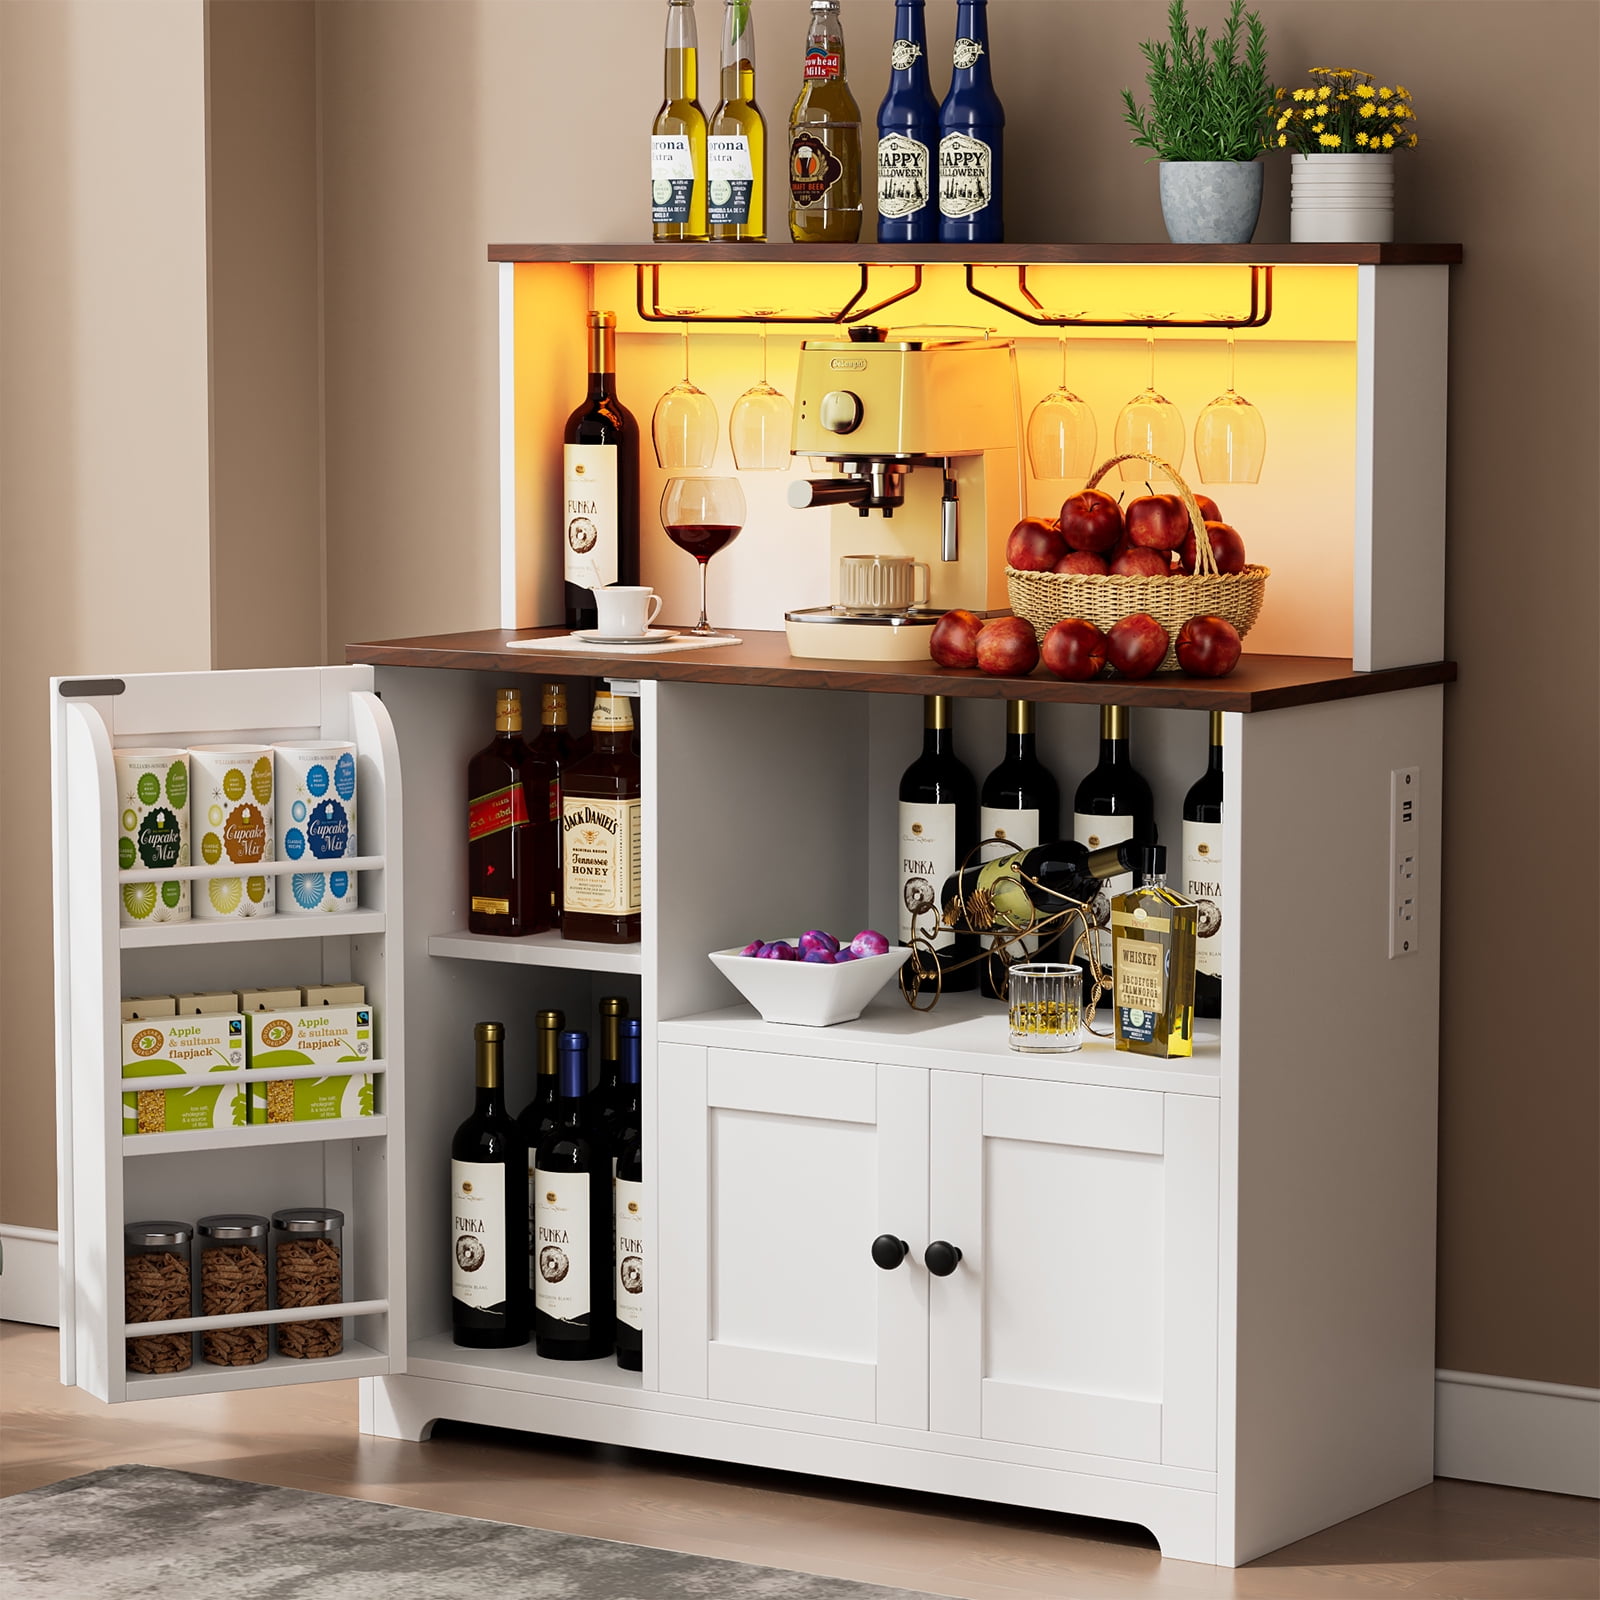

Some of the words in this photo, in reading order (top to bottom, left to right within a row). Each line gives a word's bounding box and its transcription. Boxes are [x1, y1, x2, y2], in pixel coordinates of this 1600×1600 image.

[805, 57, 837, 66] rowhead
[653, 141, 684, 150] orona
[709, 142, 744, 150] orona
[568, 500, 597, 514] FUNKA
[564, 811, 584, 832] JACK
[585, 807, 618, 835] DANIEL'S
[226, 824, 264, 843] Cupcake
[310, 820, 347, 839] Cupcake
[140, 829, 179, 848] Cupcake
[321, 835, 344, 852] Mix
[152, 844, 176, 861] Mix
[237, 840, 261, 856] Mix
[572, 853, 609, 866] Tennessee
[903, 859, 935, 875] FUNKA
[572, 866, 609, 876] HONEY
[1188, 880, 1222, 897] FUNKA
[1122, 949, 1157, 966] WHISKEY
[297, 1017, 329, 1029] Apple
[168, 1026, 201, 1038] Apple
[297, 1030, 306, 1038] &
[309, 1028, 349, 1037] sultana
[168, 1039, 177, 1048] &
[180, 1037, 221, 1047] sultana
[297, 1038, 341, 1050] flapjack
[168, 1048, 213, 1060] flapjack
[455, 1216, 485, 1233] FUNKA
[538, 1227, 569, 1244] FUNKA
[620, 1236, 643, 1254] FUNK
